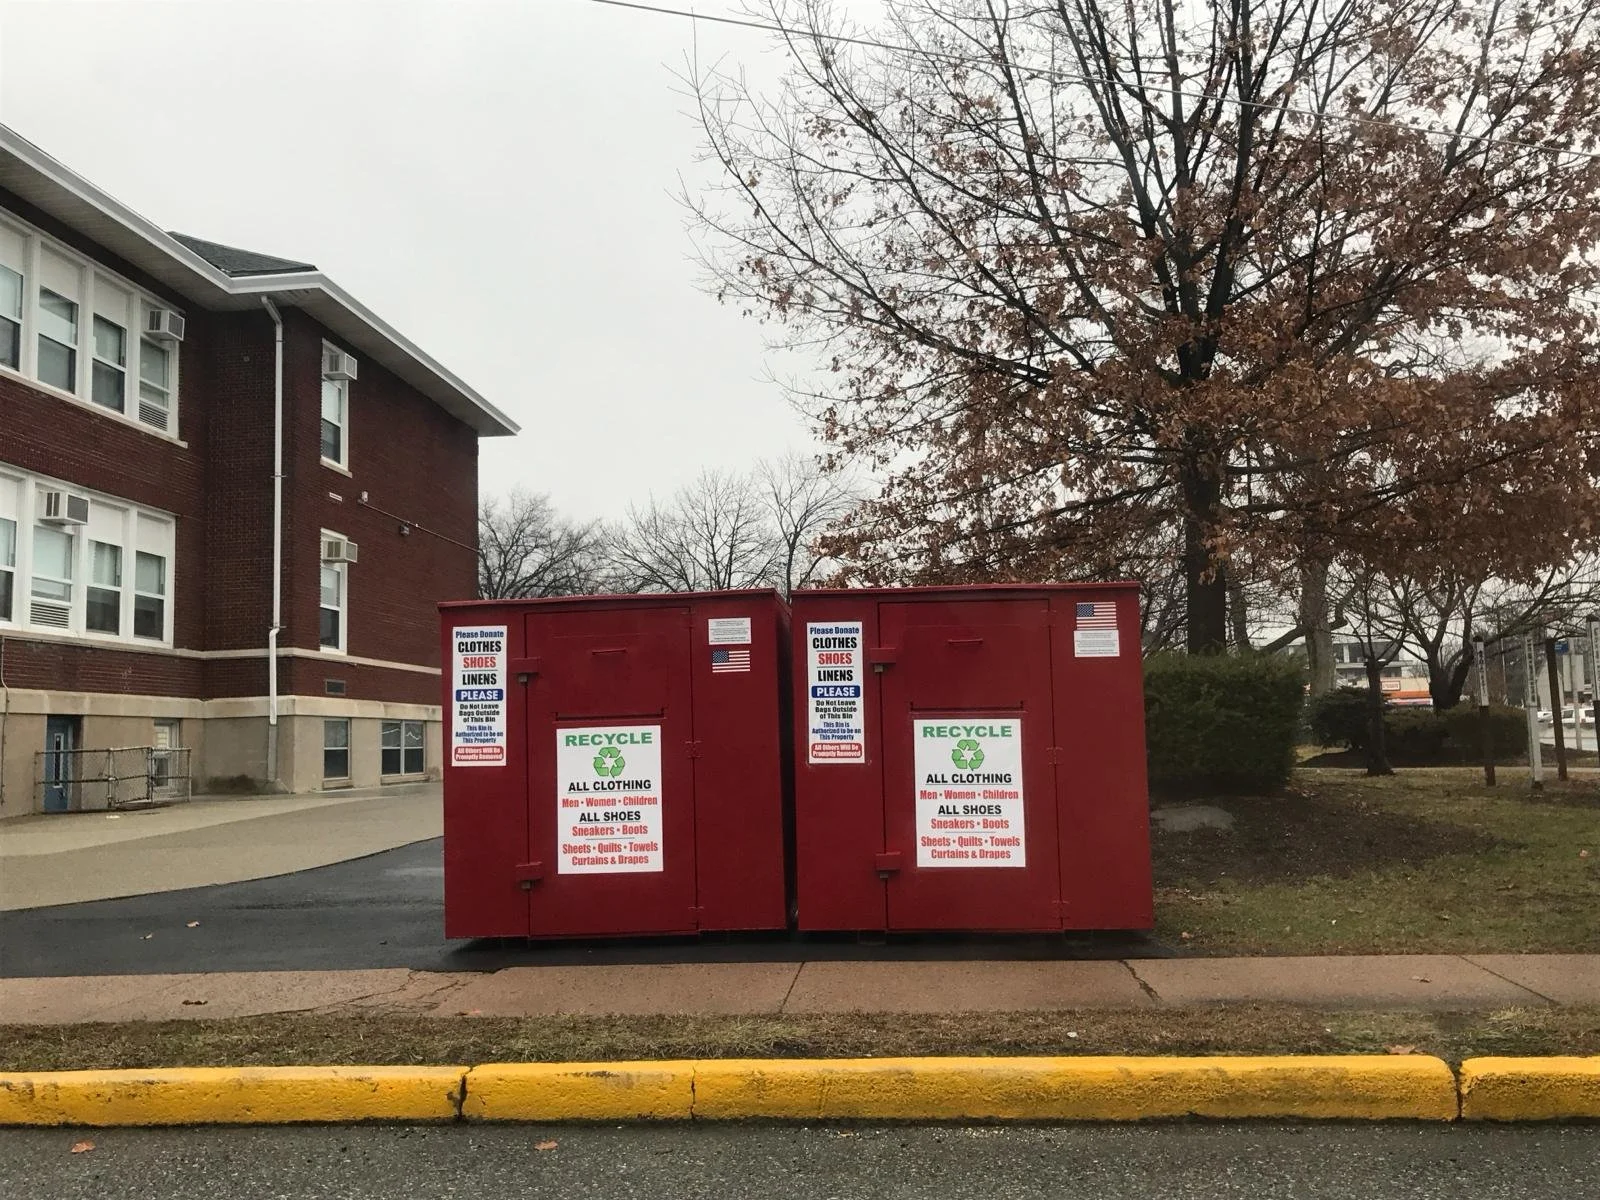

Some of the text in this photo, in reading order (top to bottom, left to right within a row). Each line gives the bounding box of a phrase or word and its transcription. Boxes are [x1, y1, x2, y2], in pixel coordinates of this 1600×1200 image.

[458, 641, 502, 653] CLOTHES
[813, 637, 857, 649] CLOTHES
[463, 657, 496, 668] SHOES
[818, 653, 852, 664] SHOES
[462, 674, 496, 685] LINENS
[818, 670, 853, 681] LINENS
[460, 690, 498, 700] PLEASE
[817, 687, 855, 696] PLEASE
[923, 726, 1012, 738] RECYCLE
[566, 732, 652, 746] RECYCLE
[926, 773, 1012, 784] ALL CLOTHING
[568, 780, 651, 792] ALL CLOTHING
[920, 790, 1018, 799] Men Women Children
[562, 796, 657, 808] Men Women Children
[938, 805, 1002, 814] ALL SHOES
[579, 811, 641, 822] ALL SHOES
[931, 818, 1009, 829] Sneakers Boots
[572, 825, 648, 836] Sneakers Boots
[921, 836, 1020, 848] Sheets Quilts Towels
[563, 842, 658, 854] Sheets Quilts Towels
[932, 849, 1011, 860] Curtains & Drapes
[572, 855, 649, 866] Curtains & Drapes
